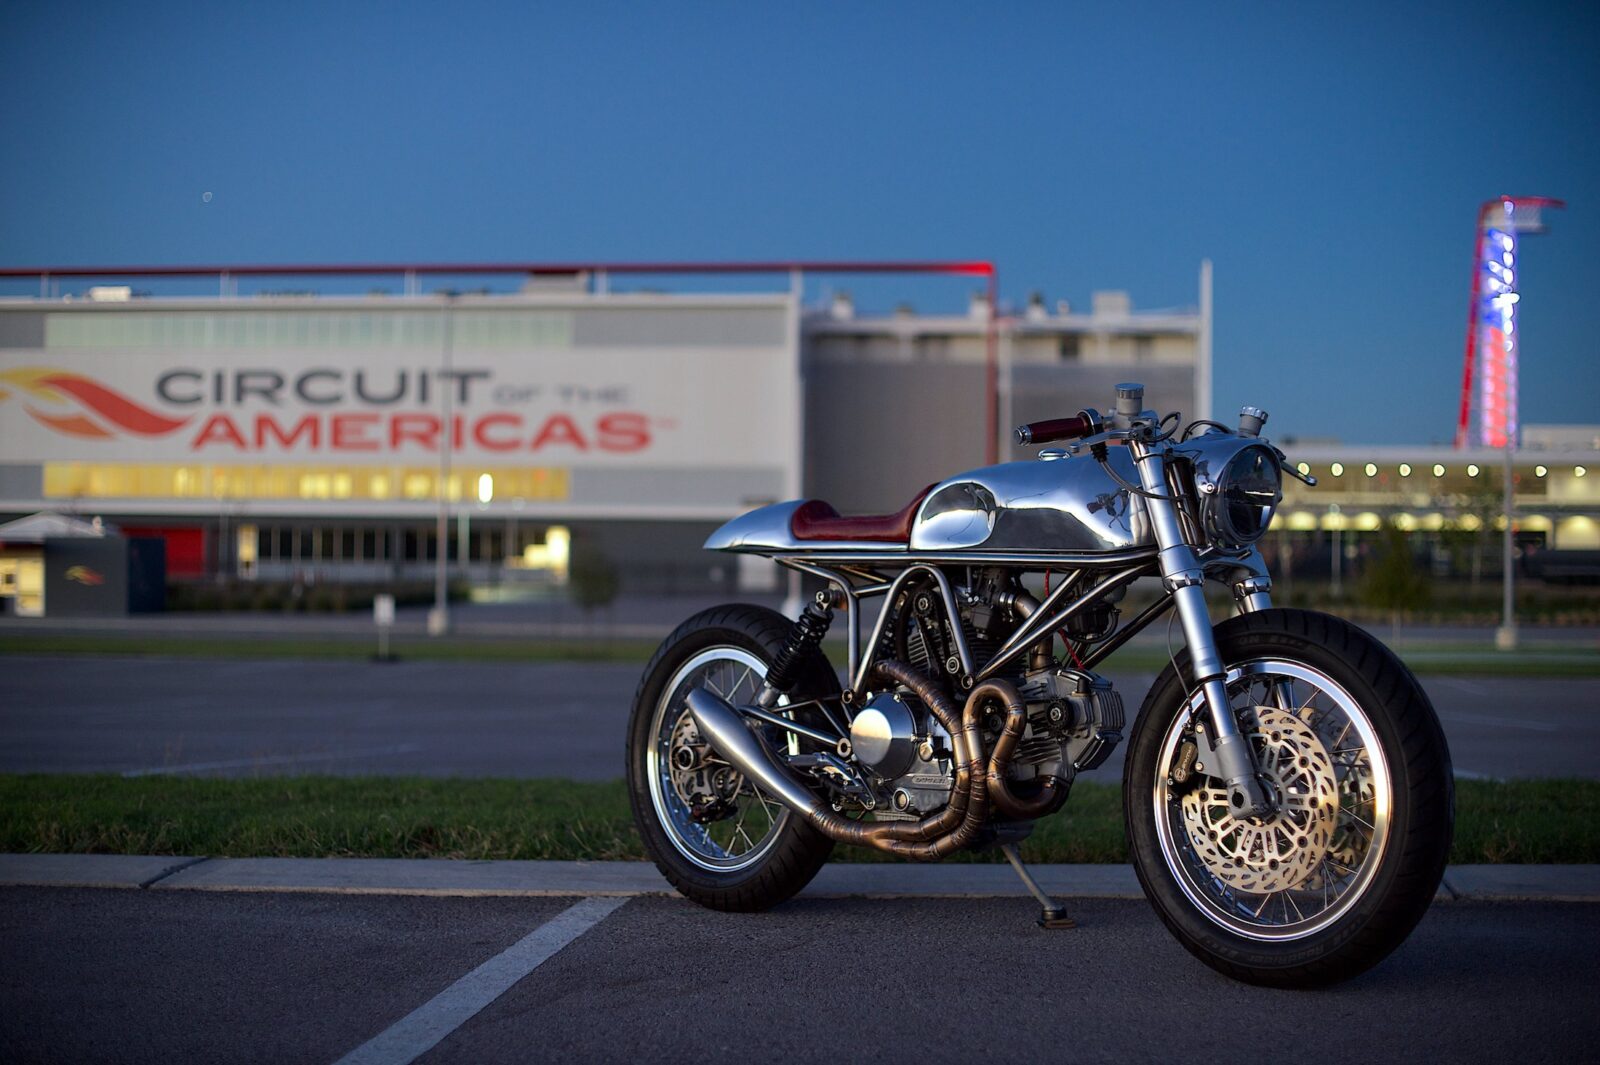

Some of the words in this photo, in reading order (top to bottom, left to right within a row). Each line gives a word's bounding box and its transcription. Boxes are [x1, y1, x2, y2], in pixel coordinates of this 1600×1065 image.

[156, 369, 490, 405] CIRCUIT
[493, 385, 539, 404] OF
[558, 385, 628, 404] THE
[192, 412, 652, 453] AMERICAS
